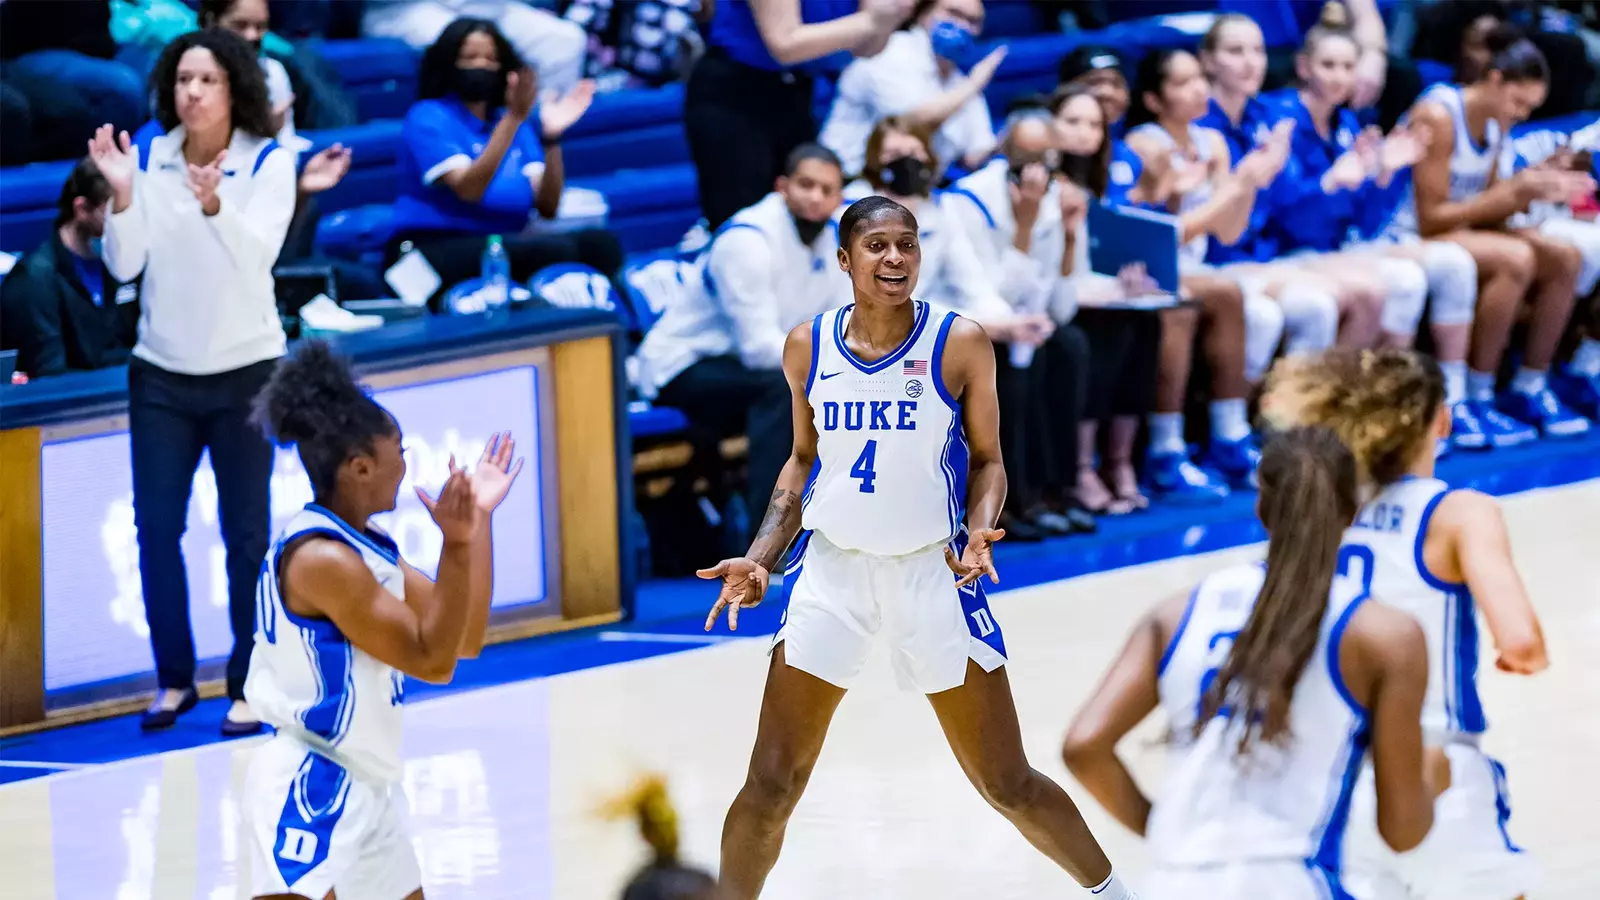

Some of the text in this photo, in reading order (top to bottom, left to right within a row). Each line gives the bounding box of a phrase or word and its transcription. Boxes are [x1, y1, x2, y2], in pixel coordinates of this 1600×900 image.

[823, 401, 917, 431] DUKE
[850, 439, 877, 493] 4
[1351, 502, 1403, 533] LOR
[970, 607, 995, 638] D
[278, 827, 318, 865] D
